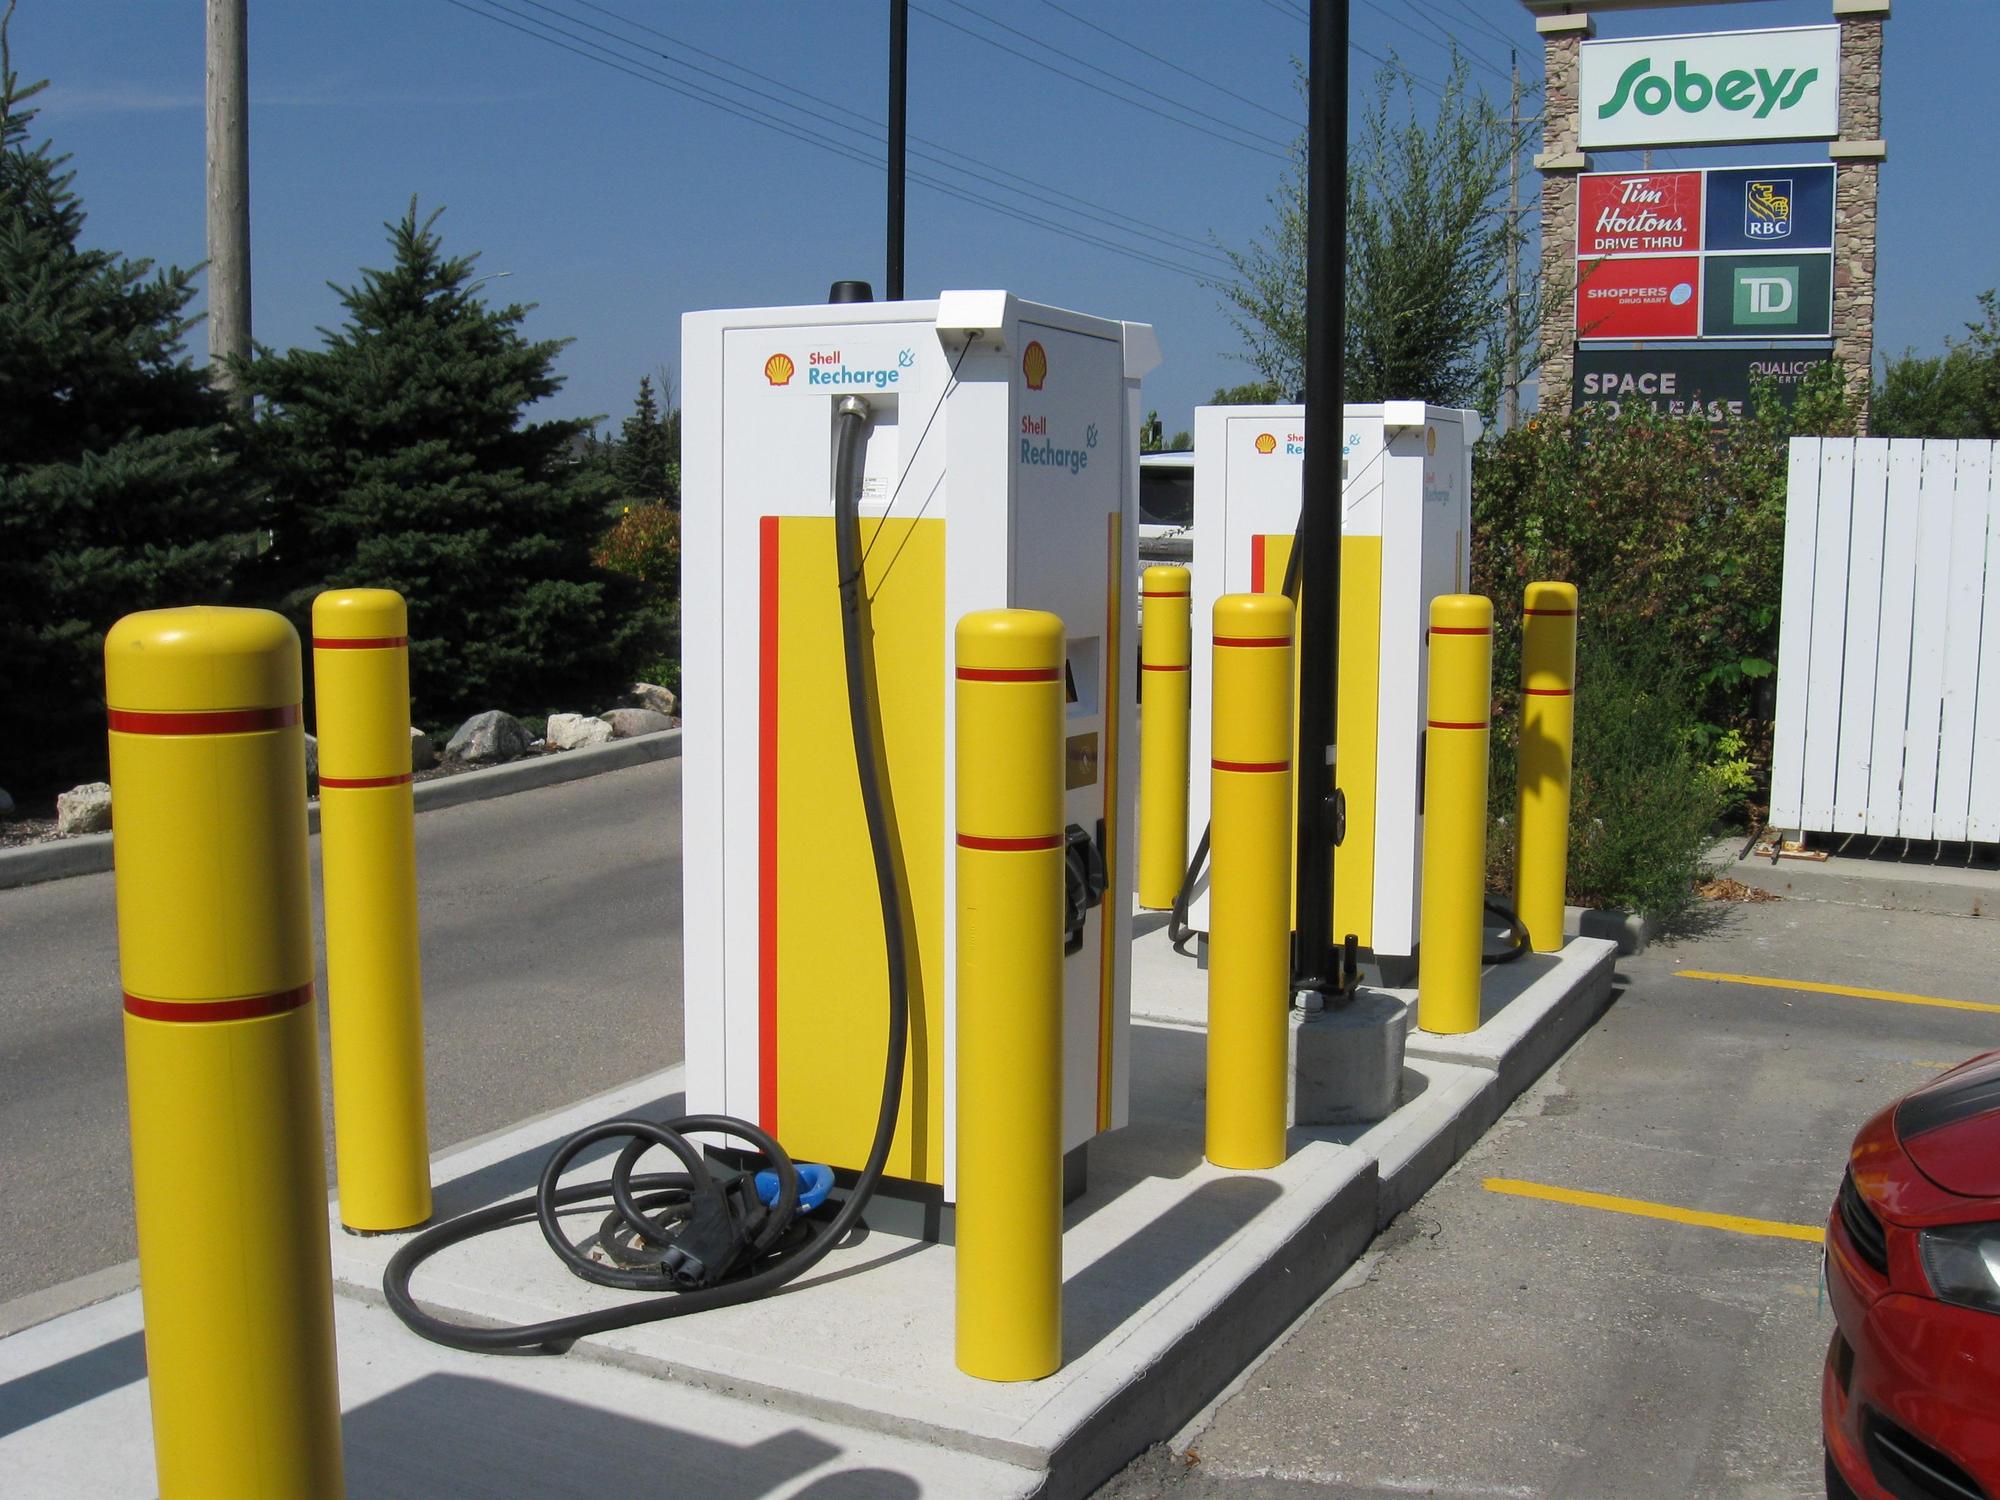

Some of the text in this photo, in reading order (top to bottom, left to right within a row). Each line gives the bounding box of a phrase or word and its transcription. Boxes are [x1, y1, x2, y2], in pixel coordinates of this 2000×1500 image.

[1598, 57, 1819, 119] Sobeys
[1621, 178, 1662, 204] Tim
[1595, 206, 1683, 233] Hortons
[1750, 221, 1787, 234] RBC
[1594, 236, 1683, 249] DRIVE THRU
[1587, 287, 1668, 298] SHOPPERS
[1740, 277, 1793, 313] TD
[809, 351, 841, 365] Shell
[809, 365, 899, 388] Recharge
[1582, 372, 1677, 395] SPACE
[1022, 415, 1047, 435] Shell
[1021, 438, 1088, 475] Recharge
